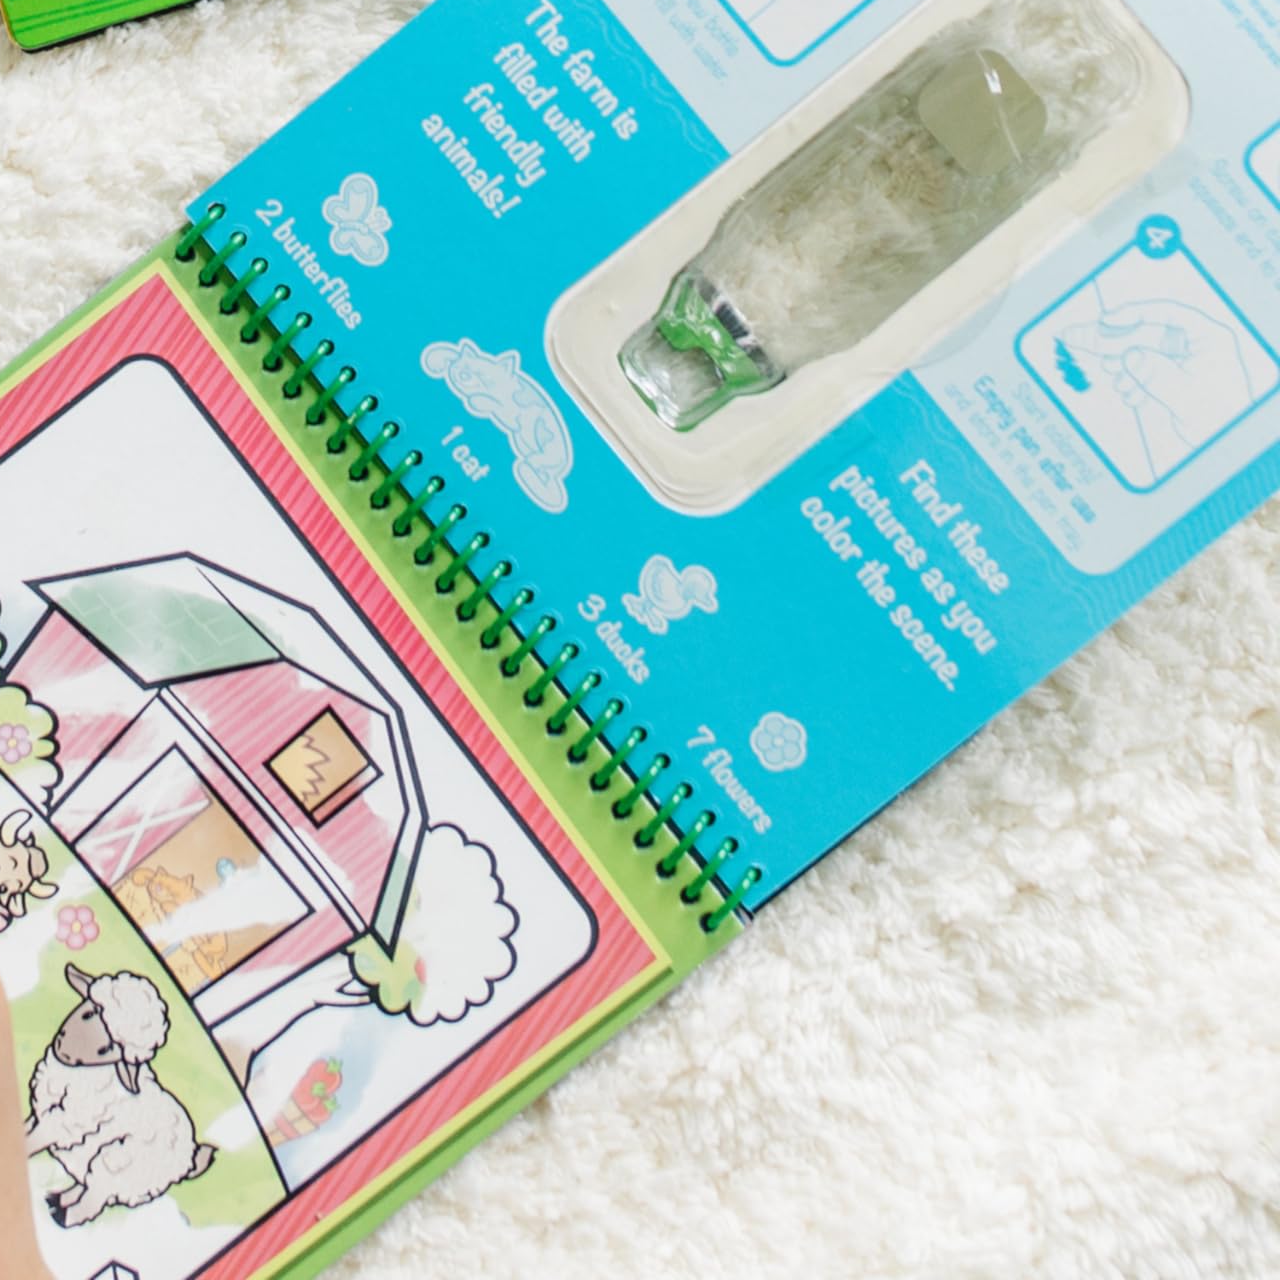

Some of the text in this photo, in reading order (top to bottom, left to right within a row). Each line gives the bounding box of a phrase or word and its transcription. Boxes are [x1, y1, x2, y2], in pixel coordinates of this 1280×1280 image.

[463, 82, 547, 189] friendly
[493, 41, 595, 163] filled with
[563, 49, 619, 117] farm
[611, 106, 639, 140] is
[421, 113, 522, 219] animals!
[255, 199, 363, 331] 2 butterflies
[1144, 225, 1176, 250] 4
[440, 425, 491, 482] 1 cat
[828, 465, 998, 656] pictures as you
[898, 458, 1011, 596] Find these
[577, 593, 650, 685] 3 ducks
[800, 496, 960, 693] color the scene.
[685, 724, 773, 834] 7 flowers
